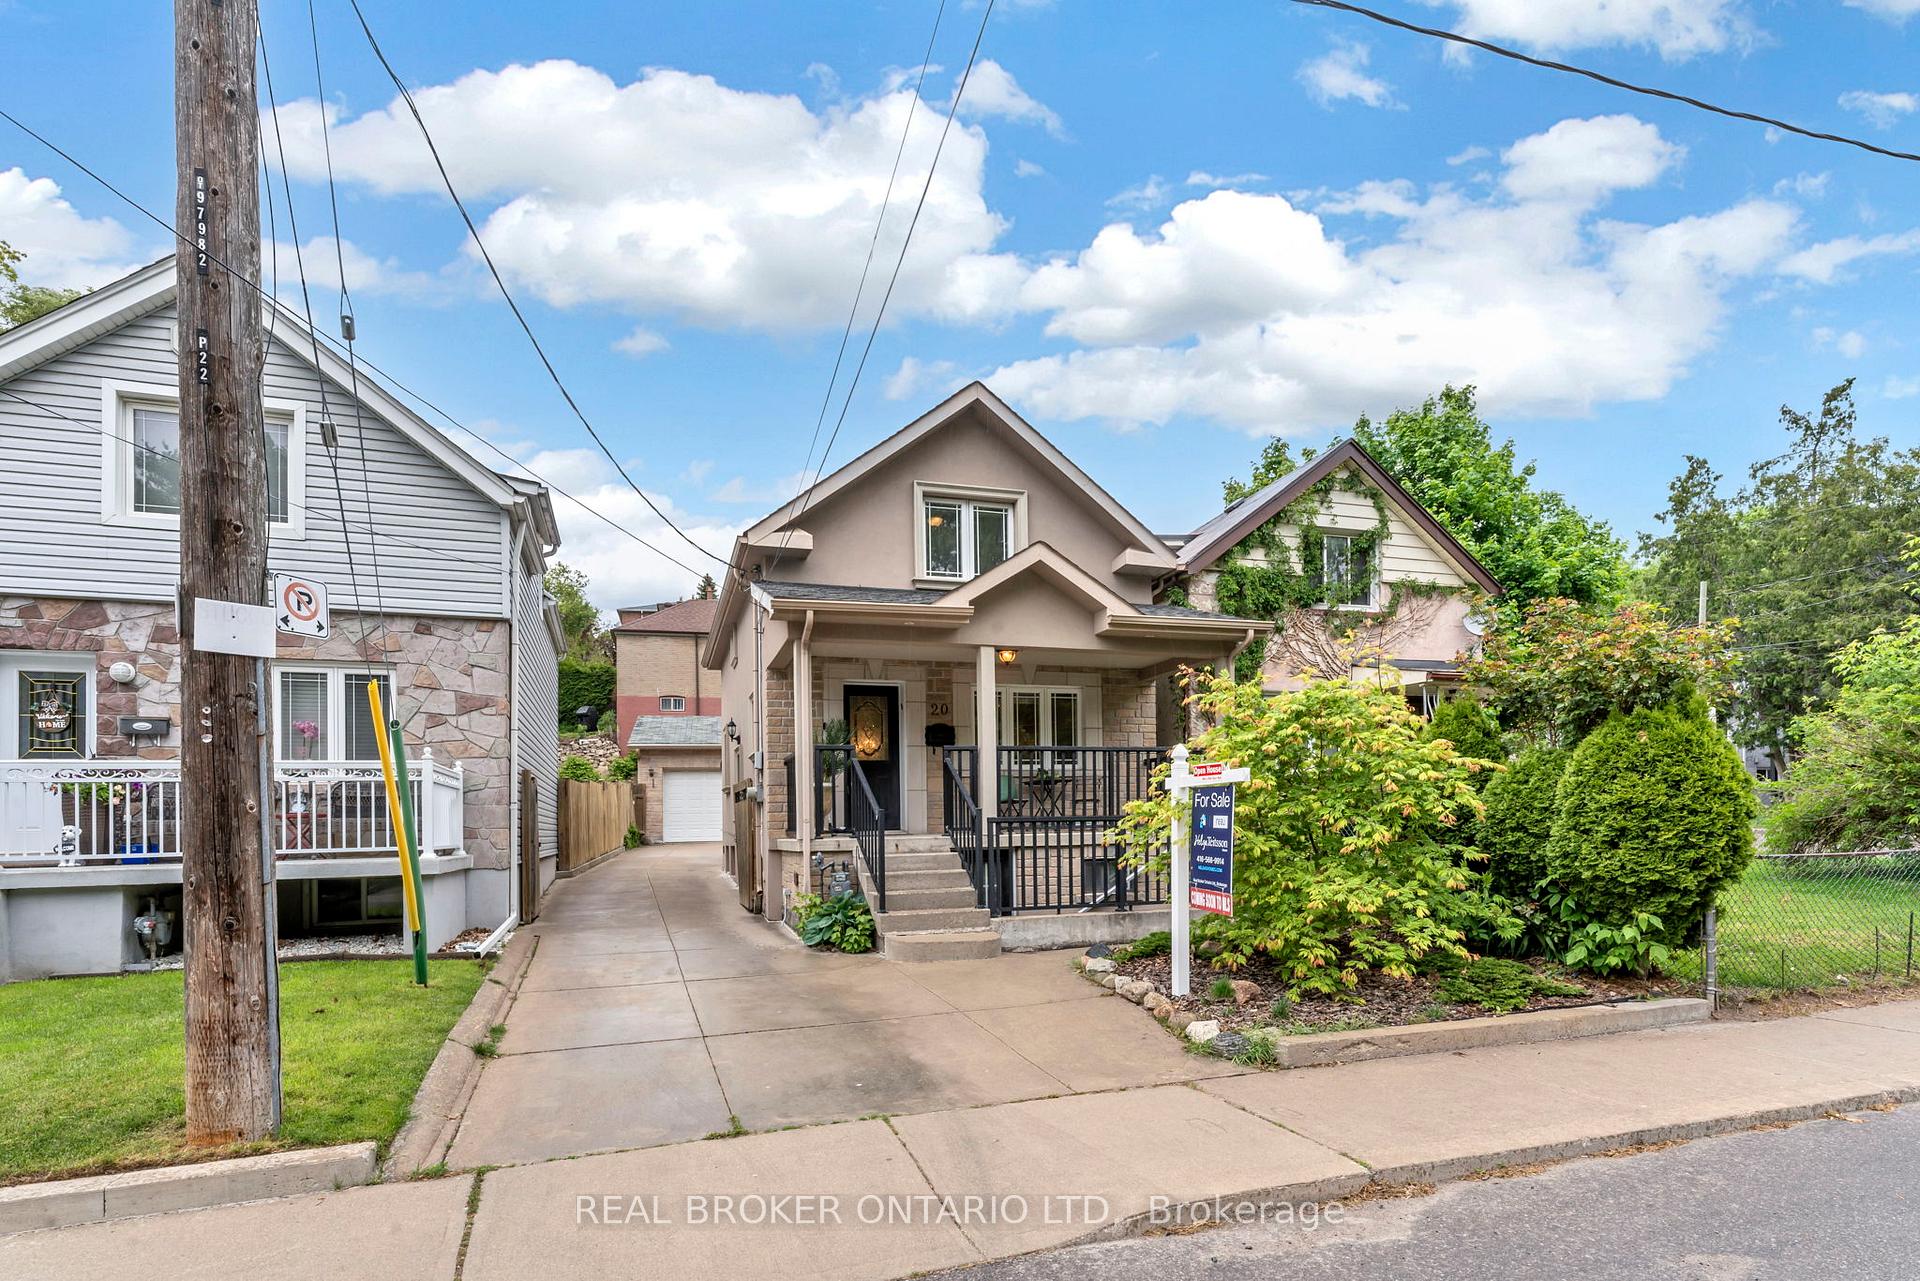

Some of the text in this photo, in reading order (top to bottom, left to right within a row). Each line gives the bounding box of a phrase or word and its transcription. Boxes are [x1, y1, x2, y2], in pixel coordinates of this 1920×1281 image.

[198, 336, 208, 380] P22
[930, 703, 949, 716] 20
[1193, 765, 1221, 776] Open House
[1194, 791, 1230, 808] For Sale
[1191, 890, 1205, 907] COMING
[1205, 892, 1216, 909] SOON
[1216, 895, 1222, 911] TO
